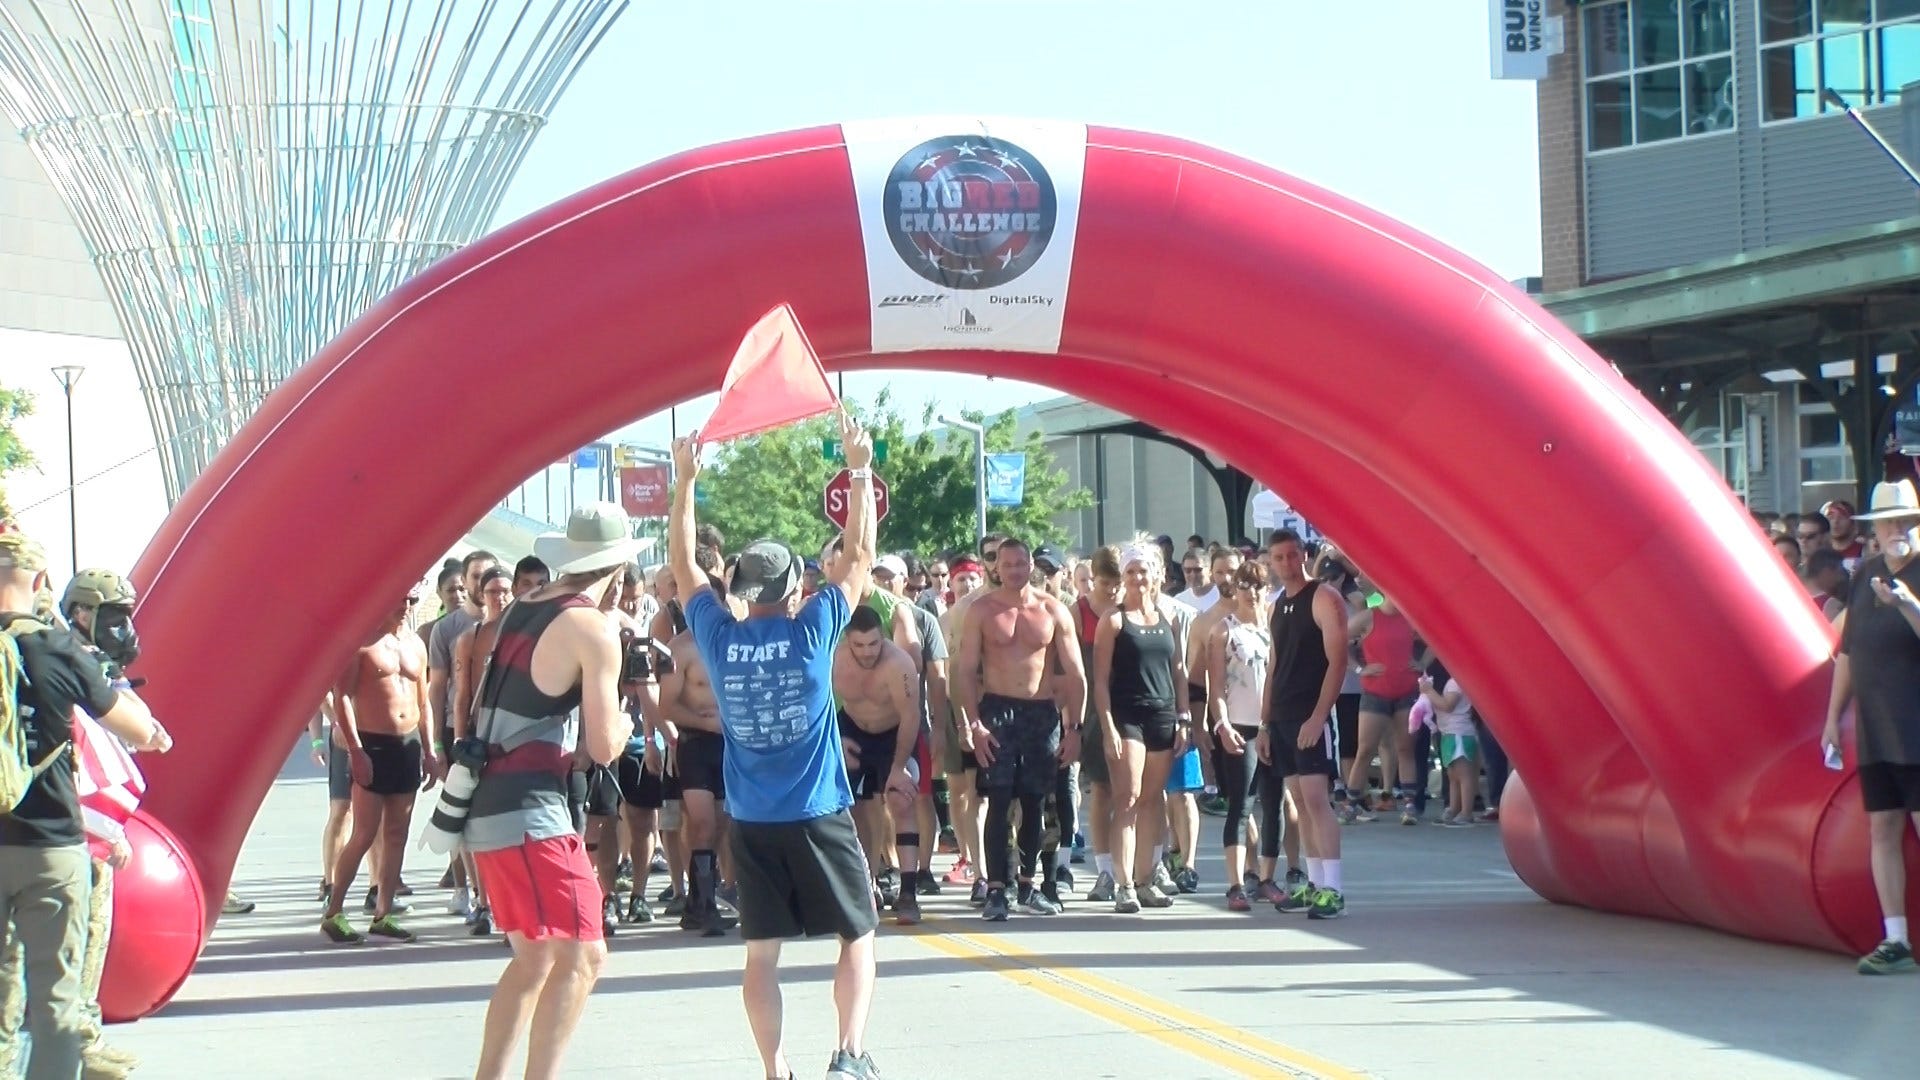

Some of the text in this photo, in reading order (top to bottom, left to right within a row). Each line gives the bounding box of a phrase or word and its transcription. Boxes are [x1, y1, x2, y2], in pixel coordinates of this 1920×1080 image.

[900, 212, 1041, 232] CHALLENGE
[989, 295, 1054, 306] DigitalSky
[1895, 410, 1920, 421] RAI
[829, 487, 884, 512] STP
[726, 640, 790, 662] STAFF
